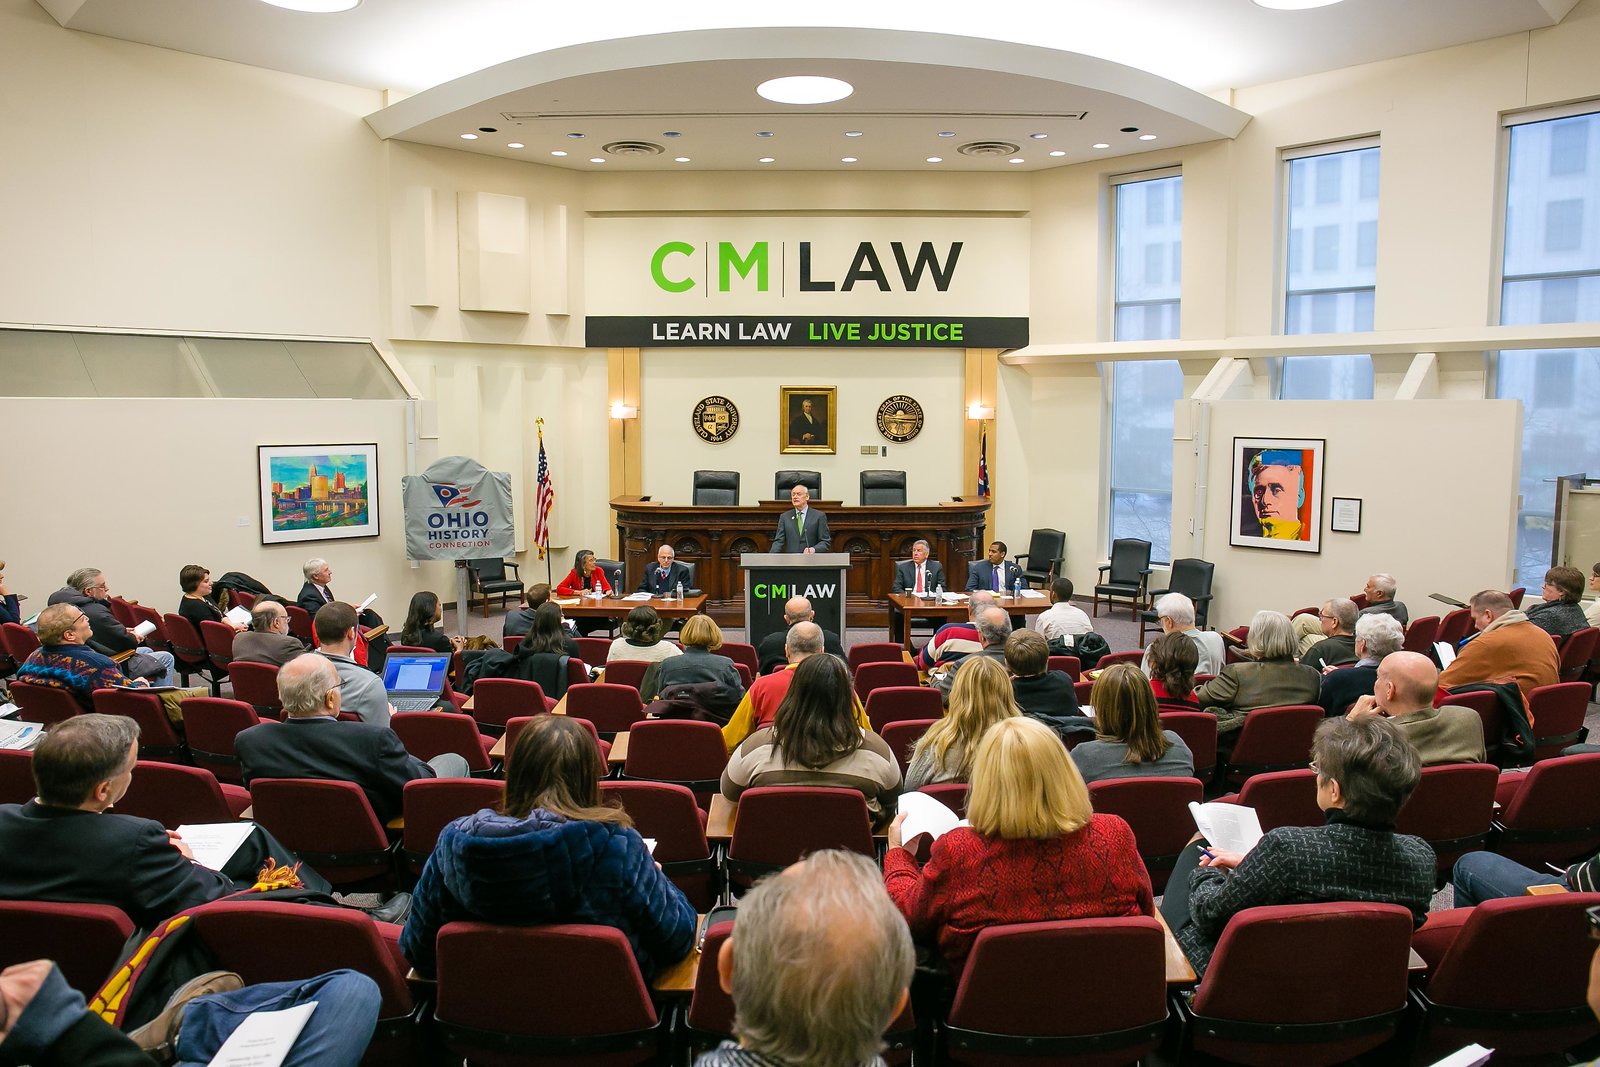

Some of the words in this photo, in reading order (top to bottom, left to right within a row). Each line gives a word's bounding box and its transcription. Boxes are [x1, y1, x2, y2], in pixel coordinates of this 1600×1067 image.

[800, 241, 964, 292] LAW
[652, 322, 730, 341] LEARN
[739, 322, 792, 341] LAW
[809, 322, 861, 341] LIVE
[868, 323, 964, 341] JUSTICE
[913, 402, 922, 418] STATE
[694, 404, 708, 438] CLEVELAND
[725, 402, 738, 438] UNIVERSITY
[906, 428, 919, 439] OHIO
[427, 511, 489, 528] OHIO
[428, 529, 489, 540] HISTORY
[429, 541, 490, 549] CONNECTION
[791, 584, 836, 599] LAW
